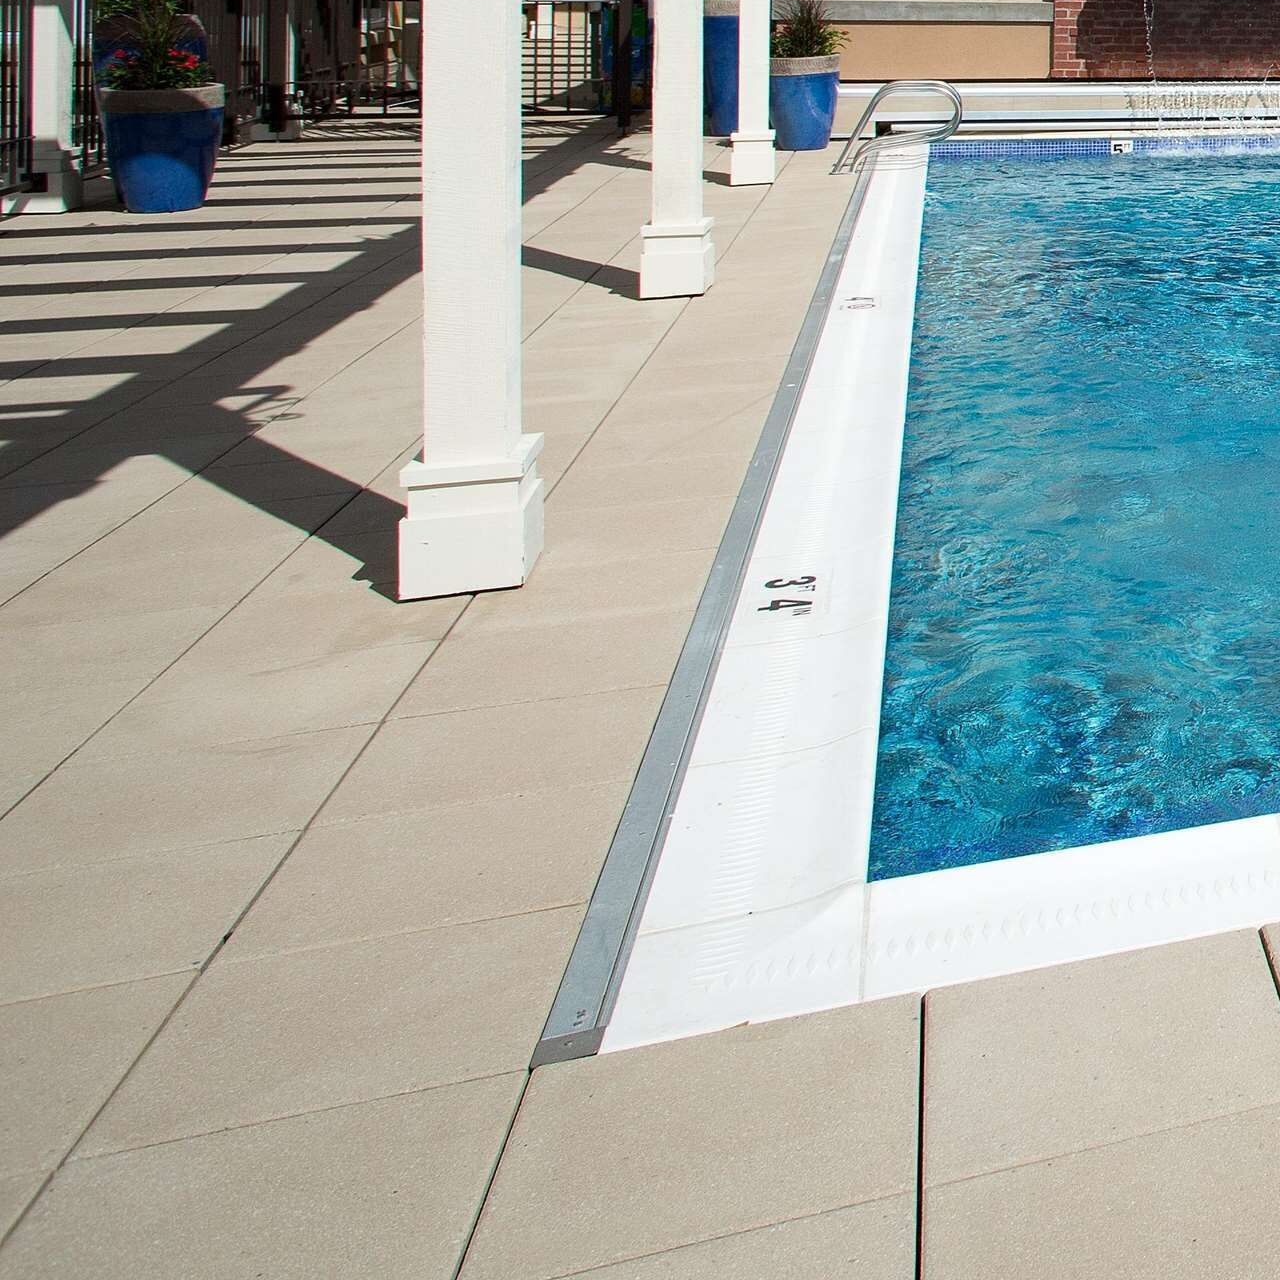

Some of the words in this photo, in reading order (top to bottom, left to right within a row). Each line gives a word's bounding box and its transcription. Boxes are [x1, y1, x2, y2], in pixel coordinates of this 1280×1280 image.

[1113, 144, 1123, 153] 5
[765, 576, 816, 589] 3
[757, 599, 813, 611] 4
